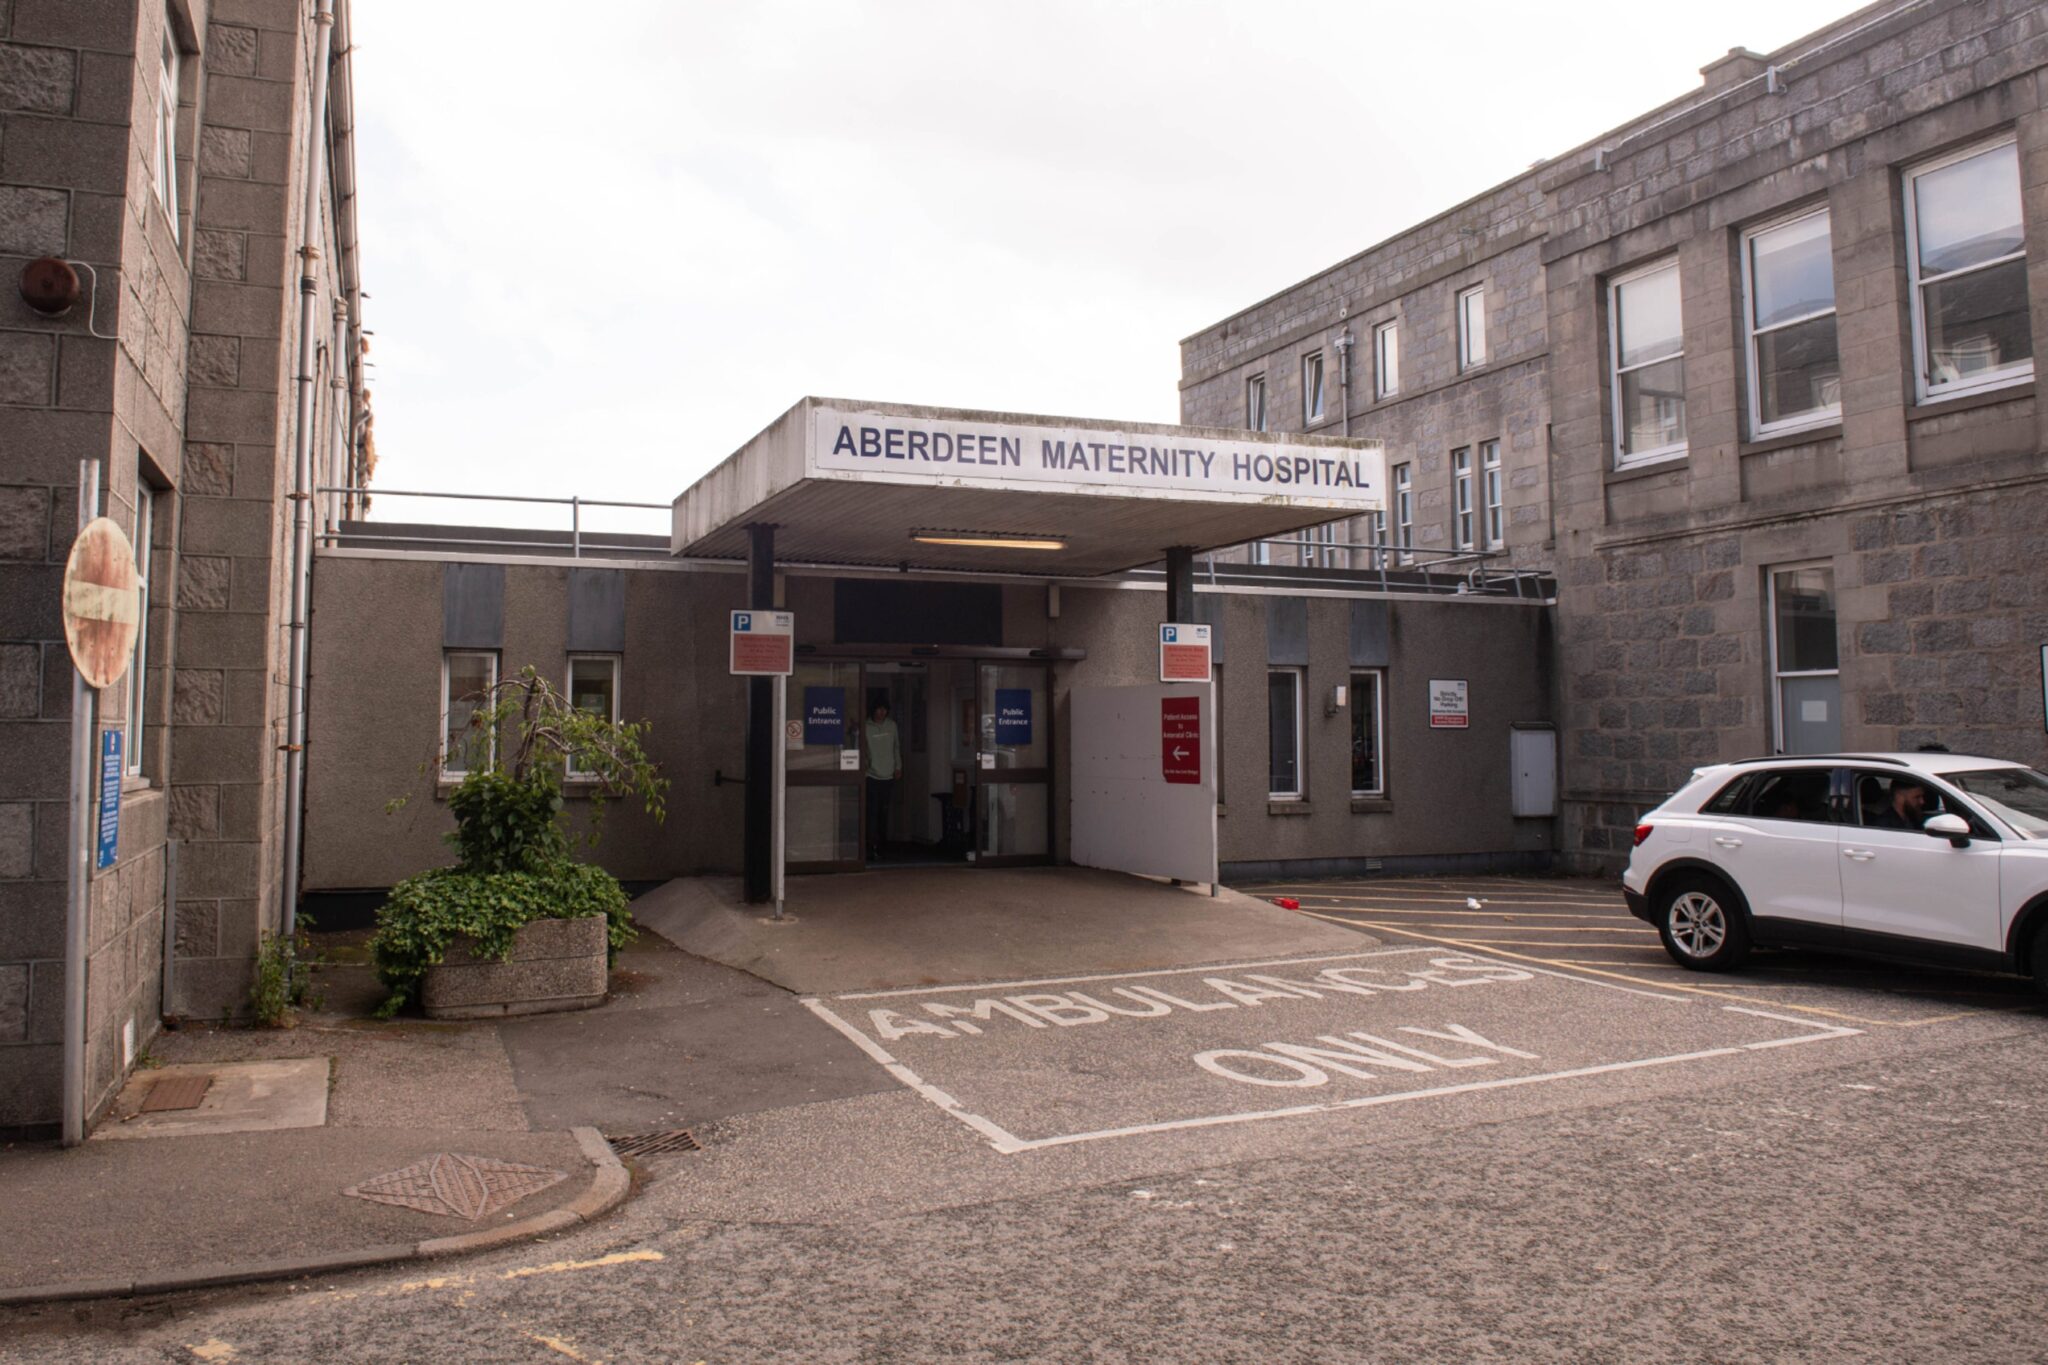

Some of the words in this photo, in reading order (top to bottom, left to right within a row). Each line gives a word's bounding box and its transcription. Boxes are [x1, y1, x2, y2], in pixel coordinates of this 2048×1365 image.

[832, 426, 1022, 467] ABERDEEN
[1041, 439, 1216, 479] MATERNITY
[1232, 452, 1370, 489] HOSPITAL
[808, 717, 841, 725] Entrance
[867, 957, 1534, 1041] AMBULANCES
[1193, 1022, 1540, 1089] ONLY
